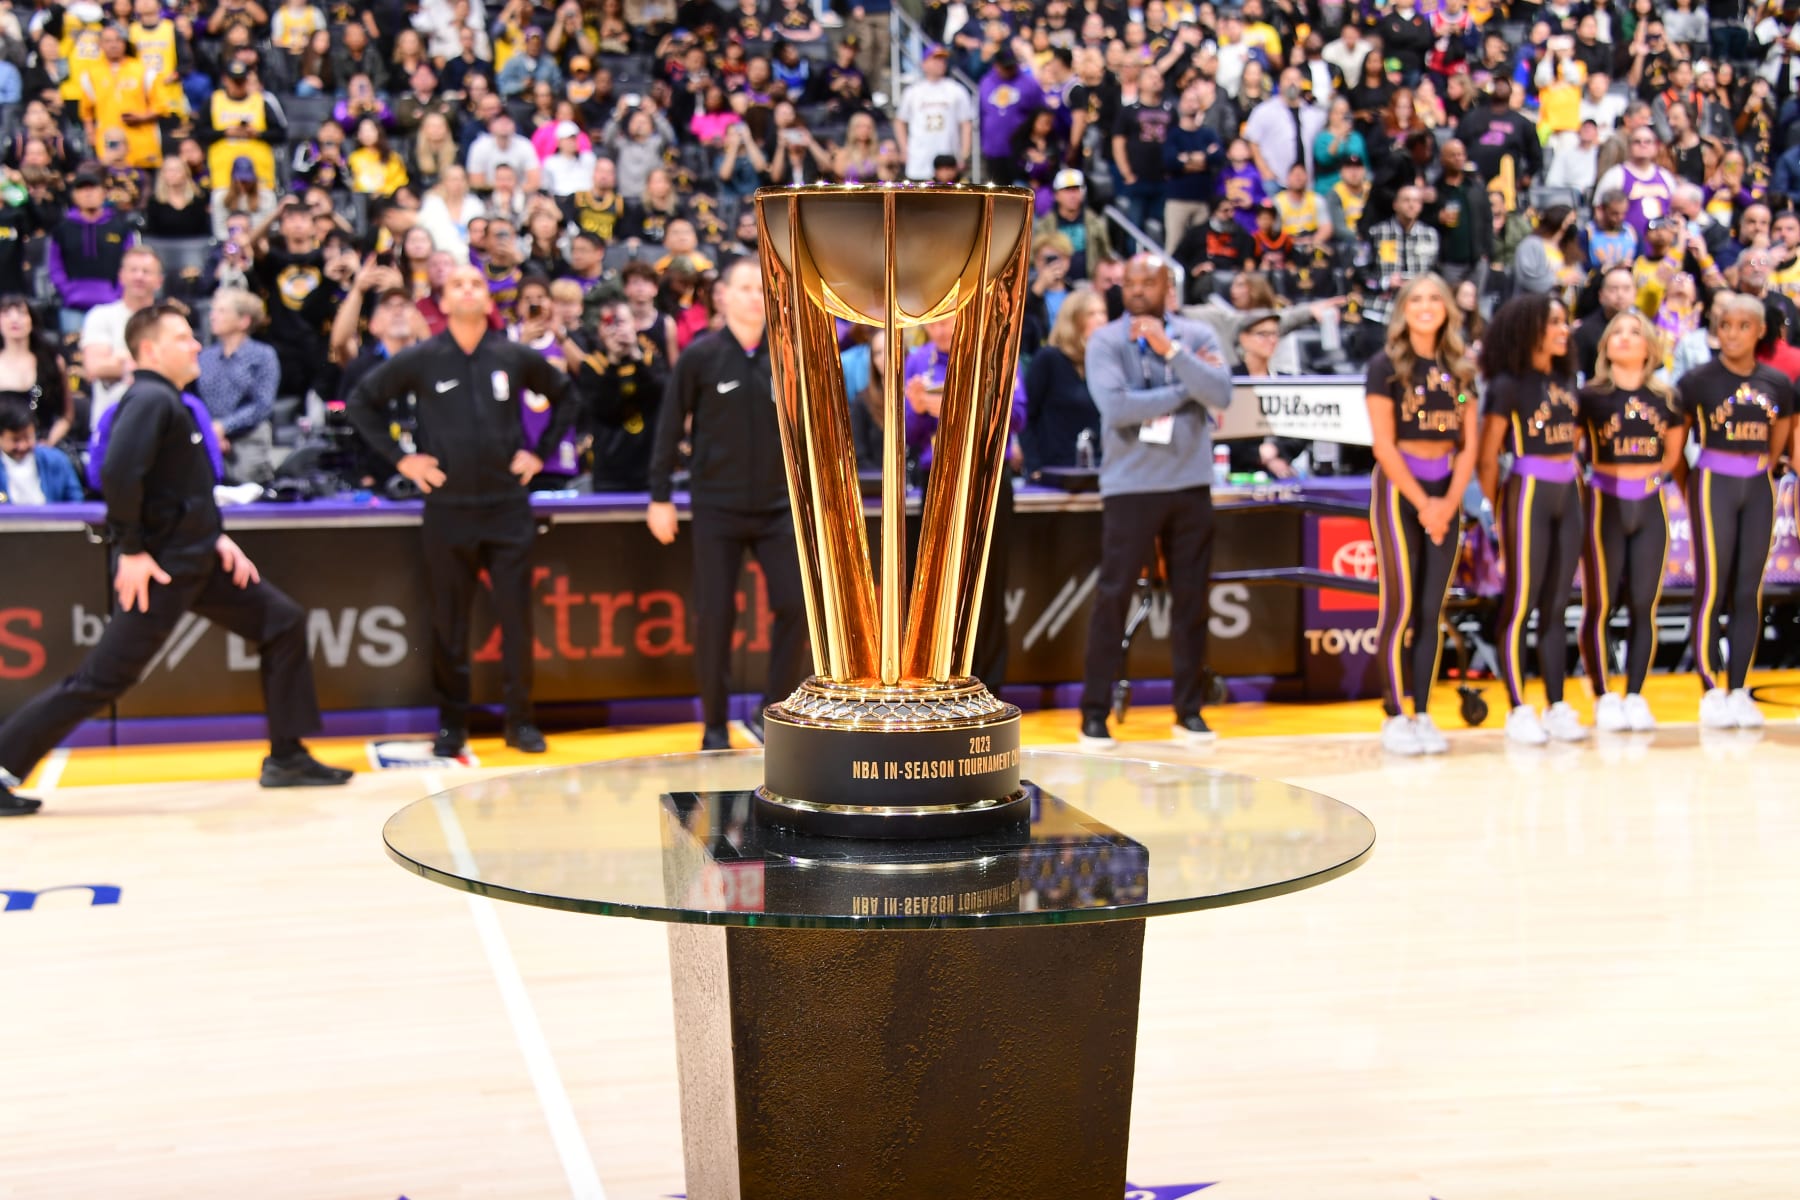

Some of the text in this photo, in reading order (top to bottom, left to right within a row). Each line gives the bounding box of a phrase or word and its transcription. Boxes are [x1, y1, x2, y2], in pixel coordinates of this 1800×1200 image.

[1258, 394, 1341, 416] Wilson
[72, 603, 112, 646] b
[1304, 628, 1414, 655] TOYO
[969, 735, 991, 754] 2023
[852, 760, 879, 780] NBA
[884, 759, 954, 780] IN-SEASON
[958, 750, 1010, 777] TOURNAMENT
